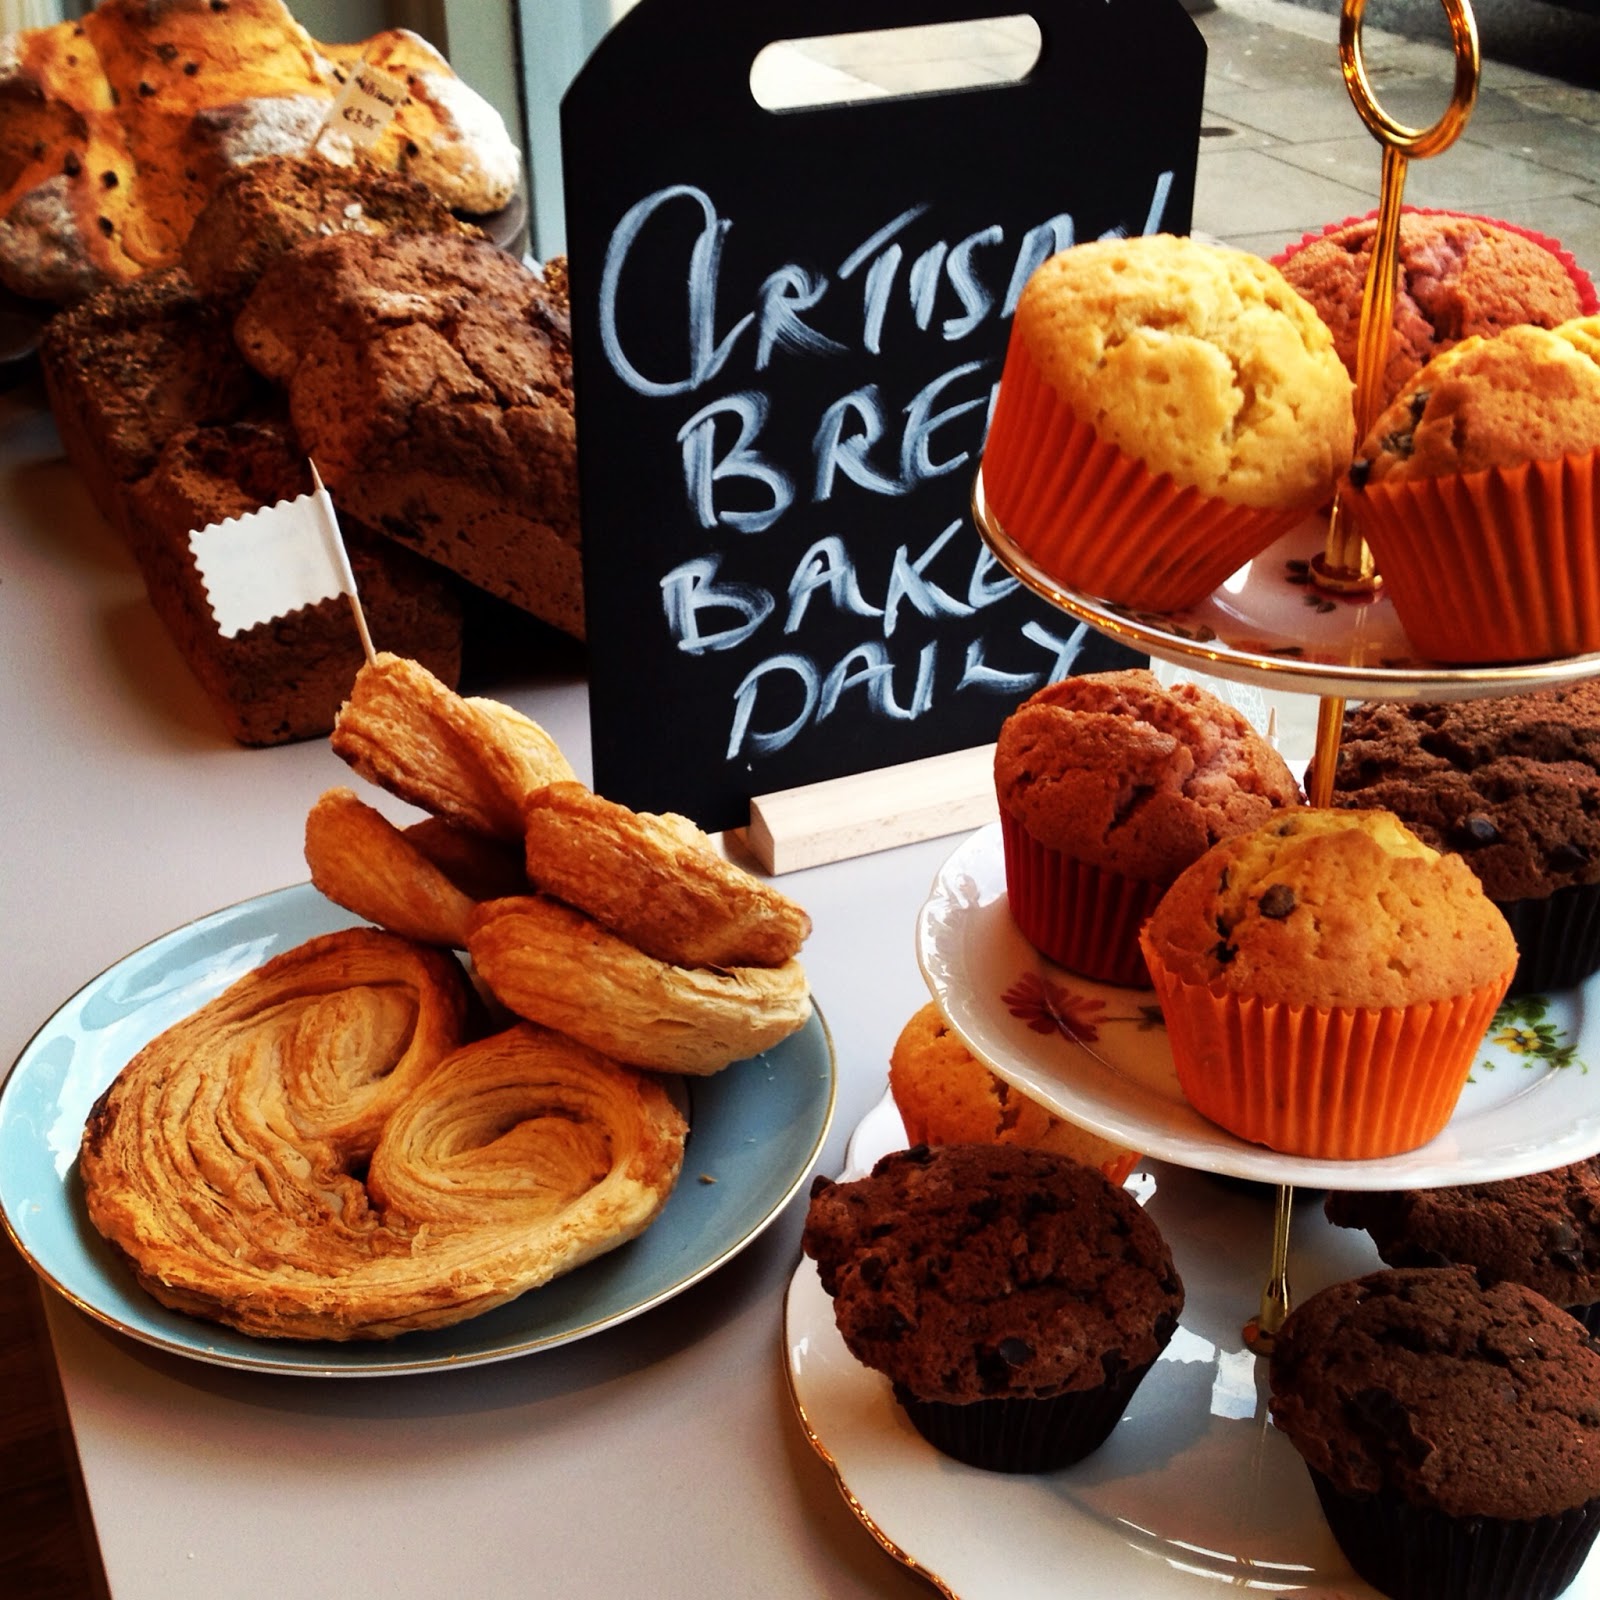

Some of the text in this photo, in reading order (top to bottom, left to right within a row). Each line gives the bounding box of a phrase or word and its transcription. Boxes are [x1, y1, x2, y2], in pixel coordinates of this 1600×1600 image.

[600, 171, 1175, 397] ARTISA
[677, 360, 1002, 533] BRE
[660, 518, 1022, 655] BAKE
[726, 620, 1089, 760] DAILY
